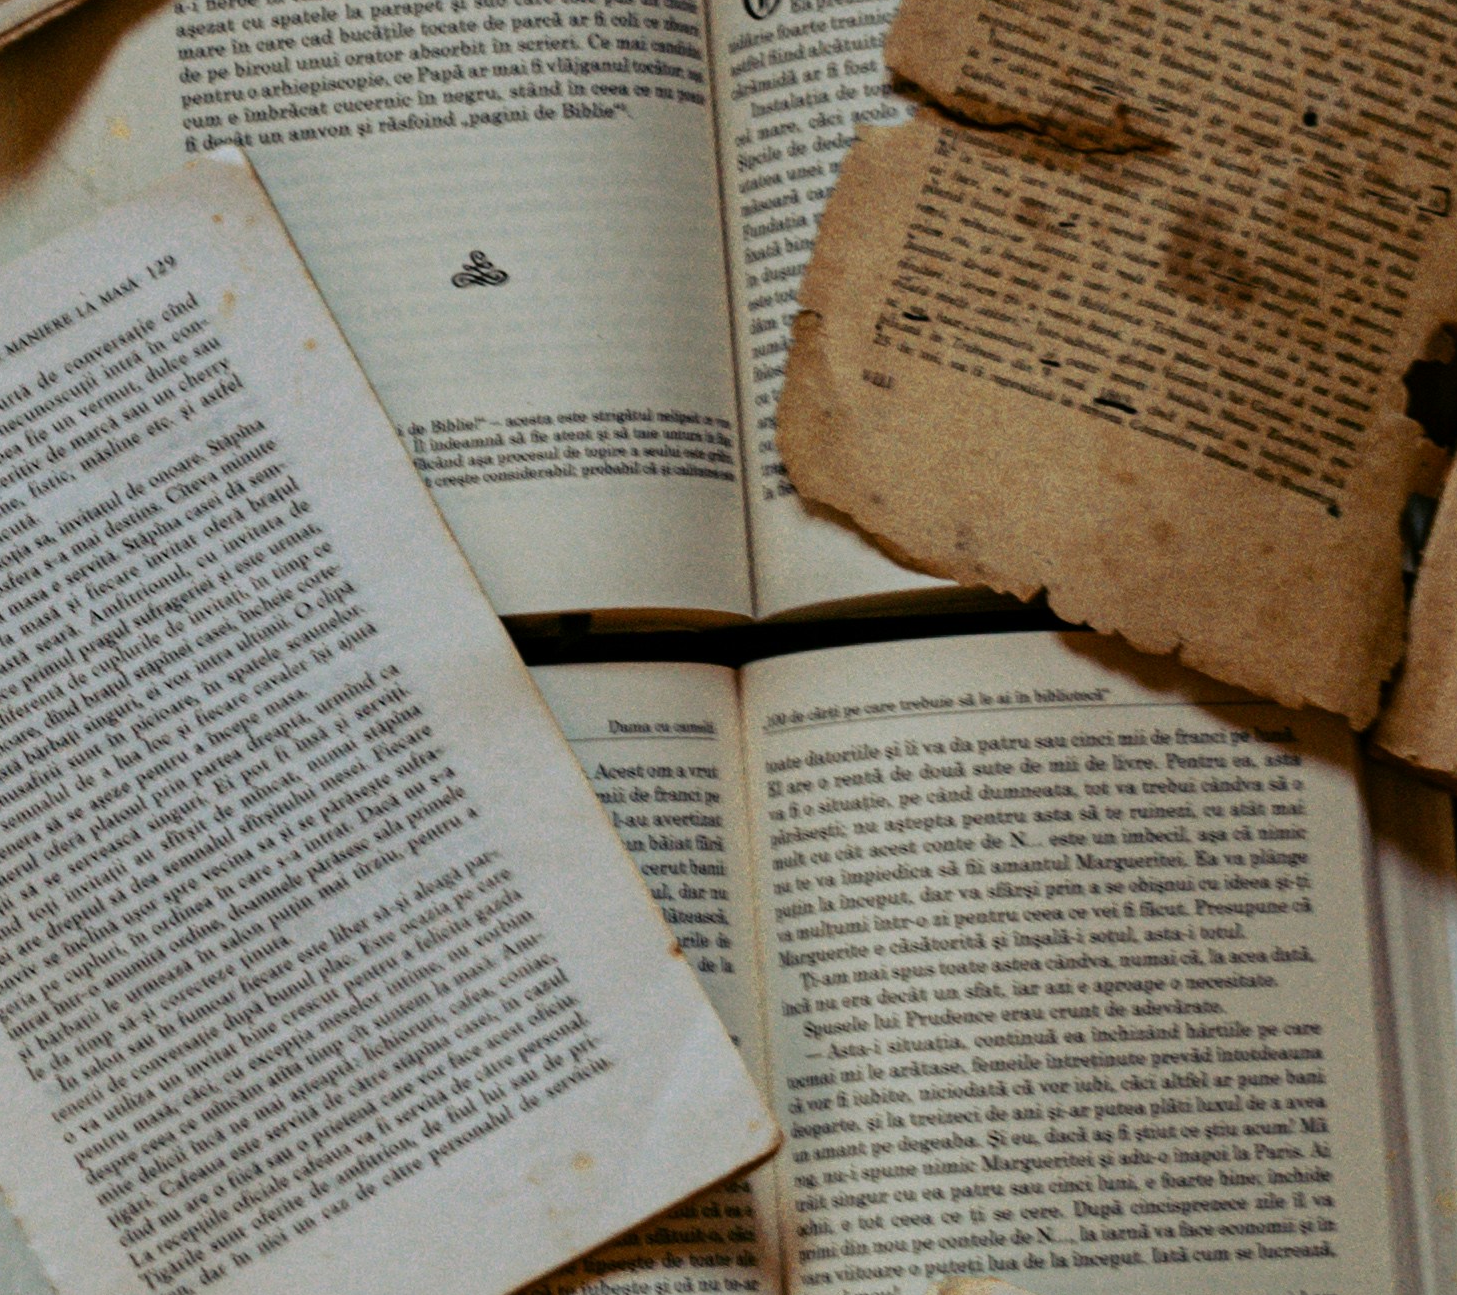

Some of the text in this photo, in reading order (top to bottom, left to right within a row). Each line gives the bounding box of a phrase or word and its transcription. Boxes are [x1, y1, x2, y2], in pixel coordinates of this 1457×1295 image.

[183, 134, 200, 155] fi
[257, 130, 285, 146] un
[287, 123, 352, 144] amvon
[355, 122, 374, 139] și
[377, 109, 457, 134] răsfoind
[532, 103, 558, 122] de
[3, 313, 74, 357] MANIERE
[74, 300, 99, 319] LA
[145, 254, 178, 280] 129
[36, 370, 59, 391] de
[63, 318, 156, 376] conversație
[161, 290, 200, 324] cînd
[802, 998, 1226, 1041] Spusele lui Prudence erau crunt de adevărate.
[198, 1264, 227, 1287] dar
[230, 1251, 253, 1269] în
[256, 1231, 290, 1256] nici
[292, 1216, 318, 1236] un
[320, 1198, 351, 1221] caz
[354, 1182, 377, 1203] de
[381, 1158, 424, 1188] către
[427, 1103, 515, 1168] personalul
[518, 1094, 541, 1114] de
[544, 1057, 613, 1100] serviciu.
